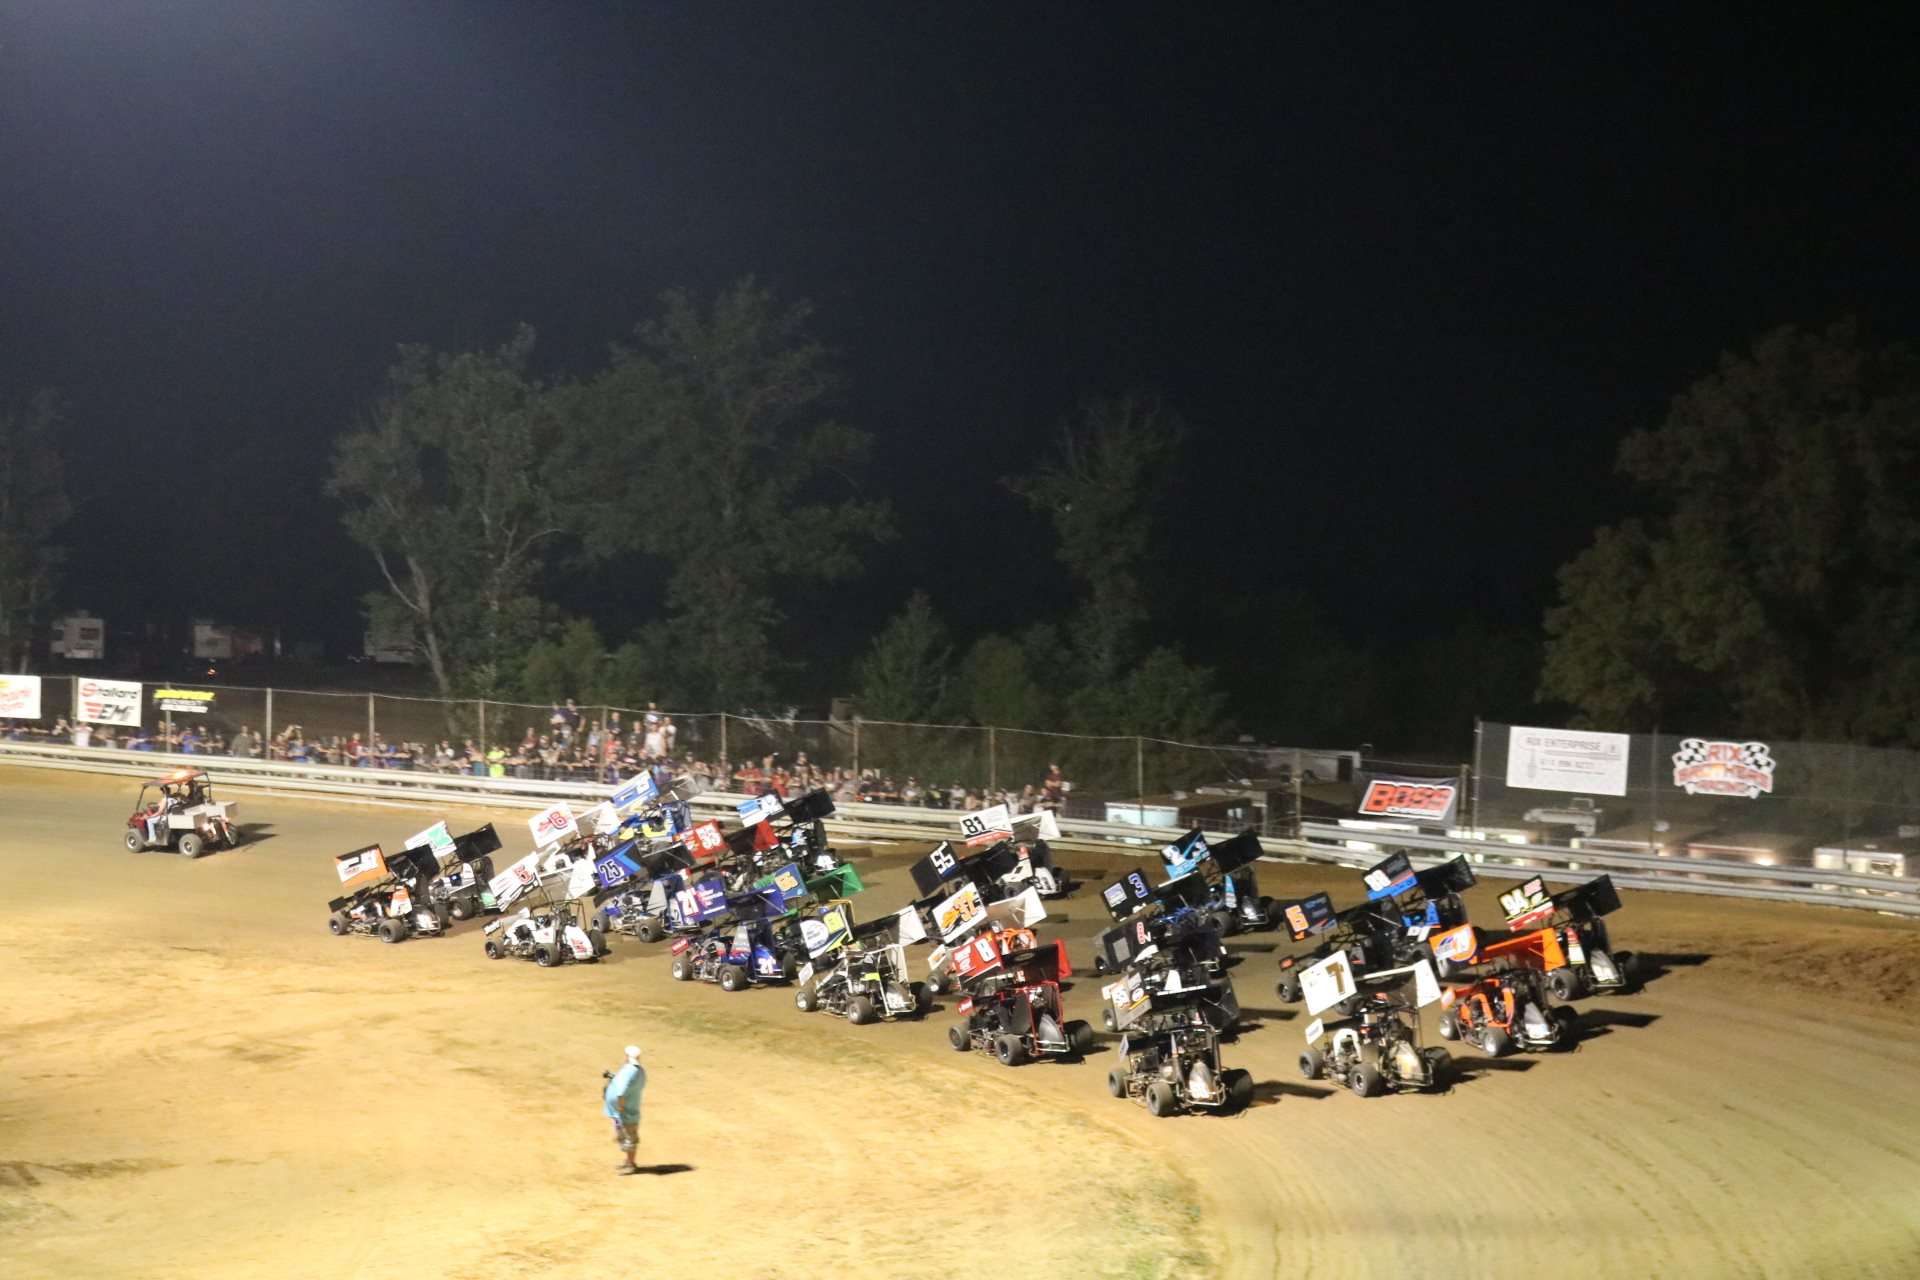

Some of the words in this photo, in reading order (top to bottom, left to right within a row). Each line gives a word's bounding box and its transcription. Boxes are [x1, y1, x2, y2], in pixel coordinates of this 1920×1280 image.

[962, 816, 987, 834] 81
[930, 840, 956, 875] 55
[600, 860, 622, 881] 25
